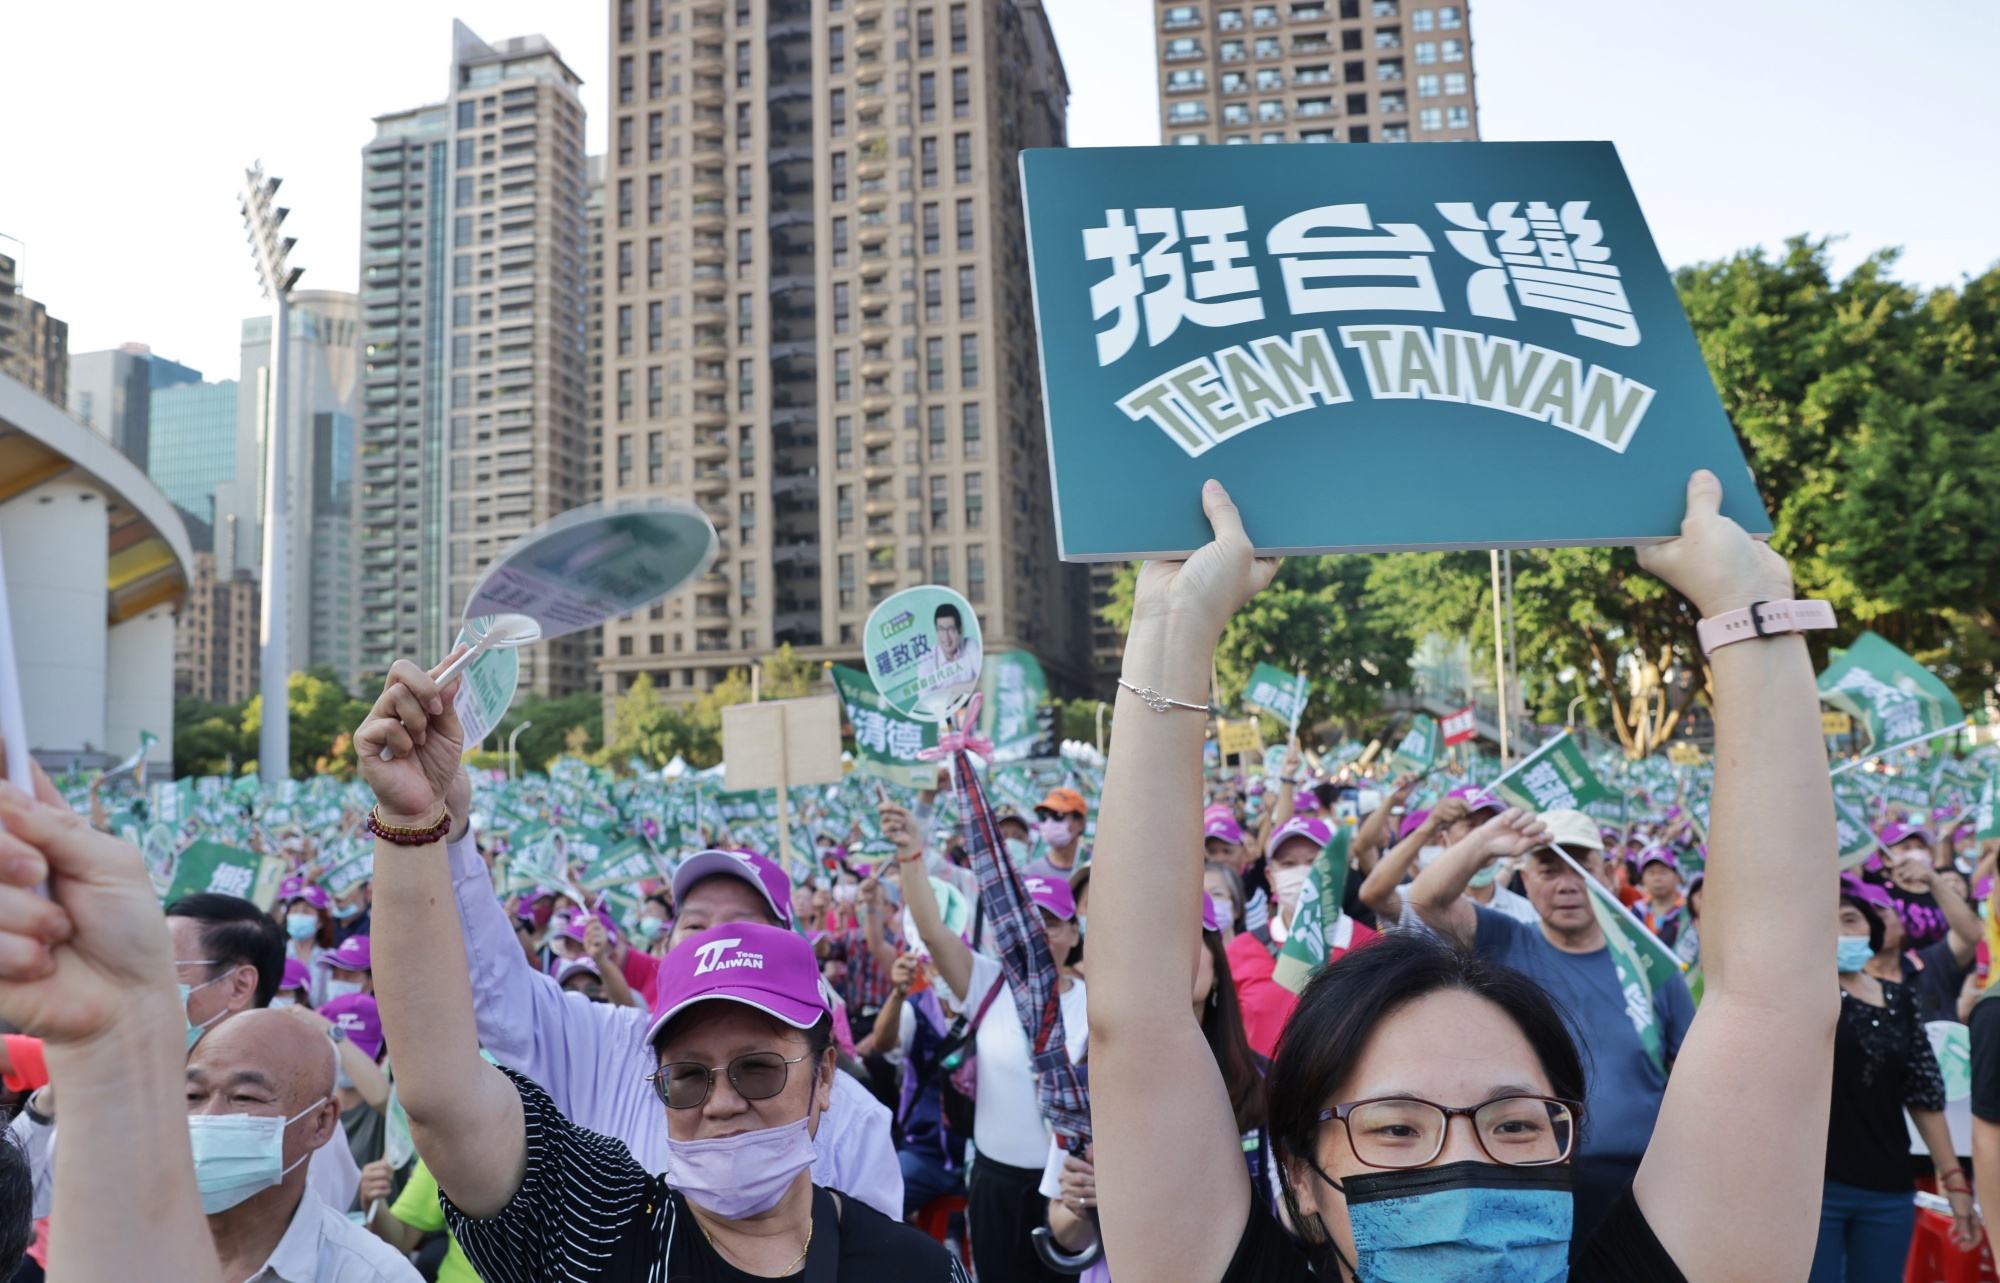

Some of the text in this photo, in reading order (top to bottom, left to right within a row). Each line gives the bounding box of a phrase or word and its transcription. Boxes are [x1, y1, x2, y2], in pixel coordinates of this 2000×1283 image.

[1083, 200, 1641, 367] 挺台灣
[1116, 324, 1656, 458] TEAM TAIWAN
[736, 951, 763, 960] Team
